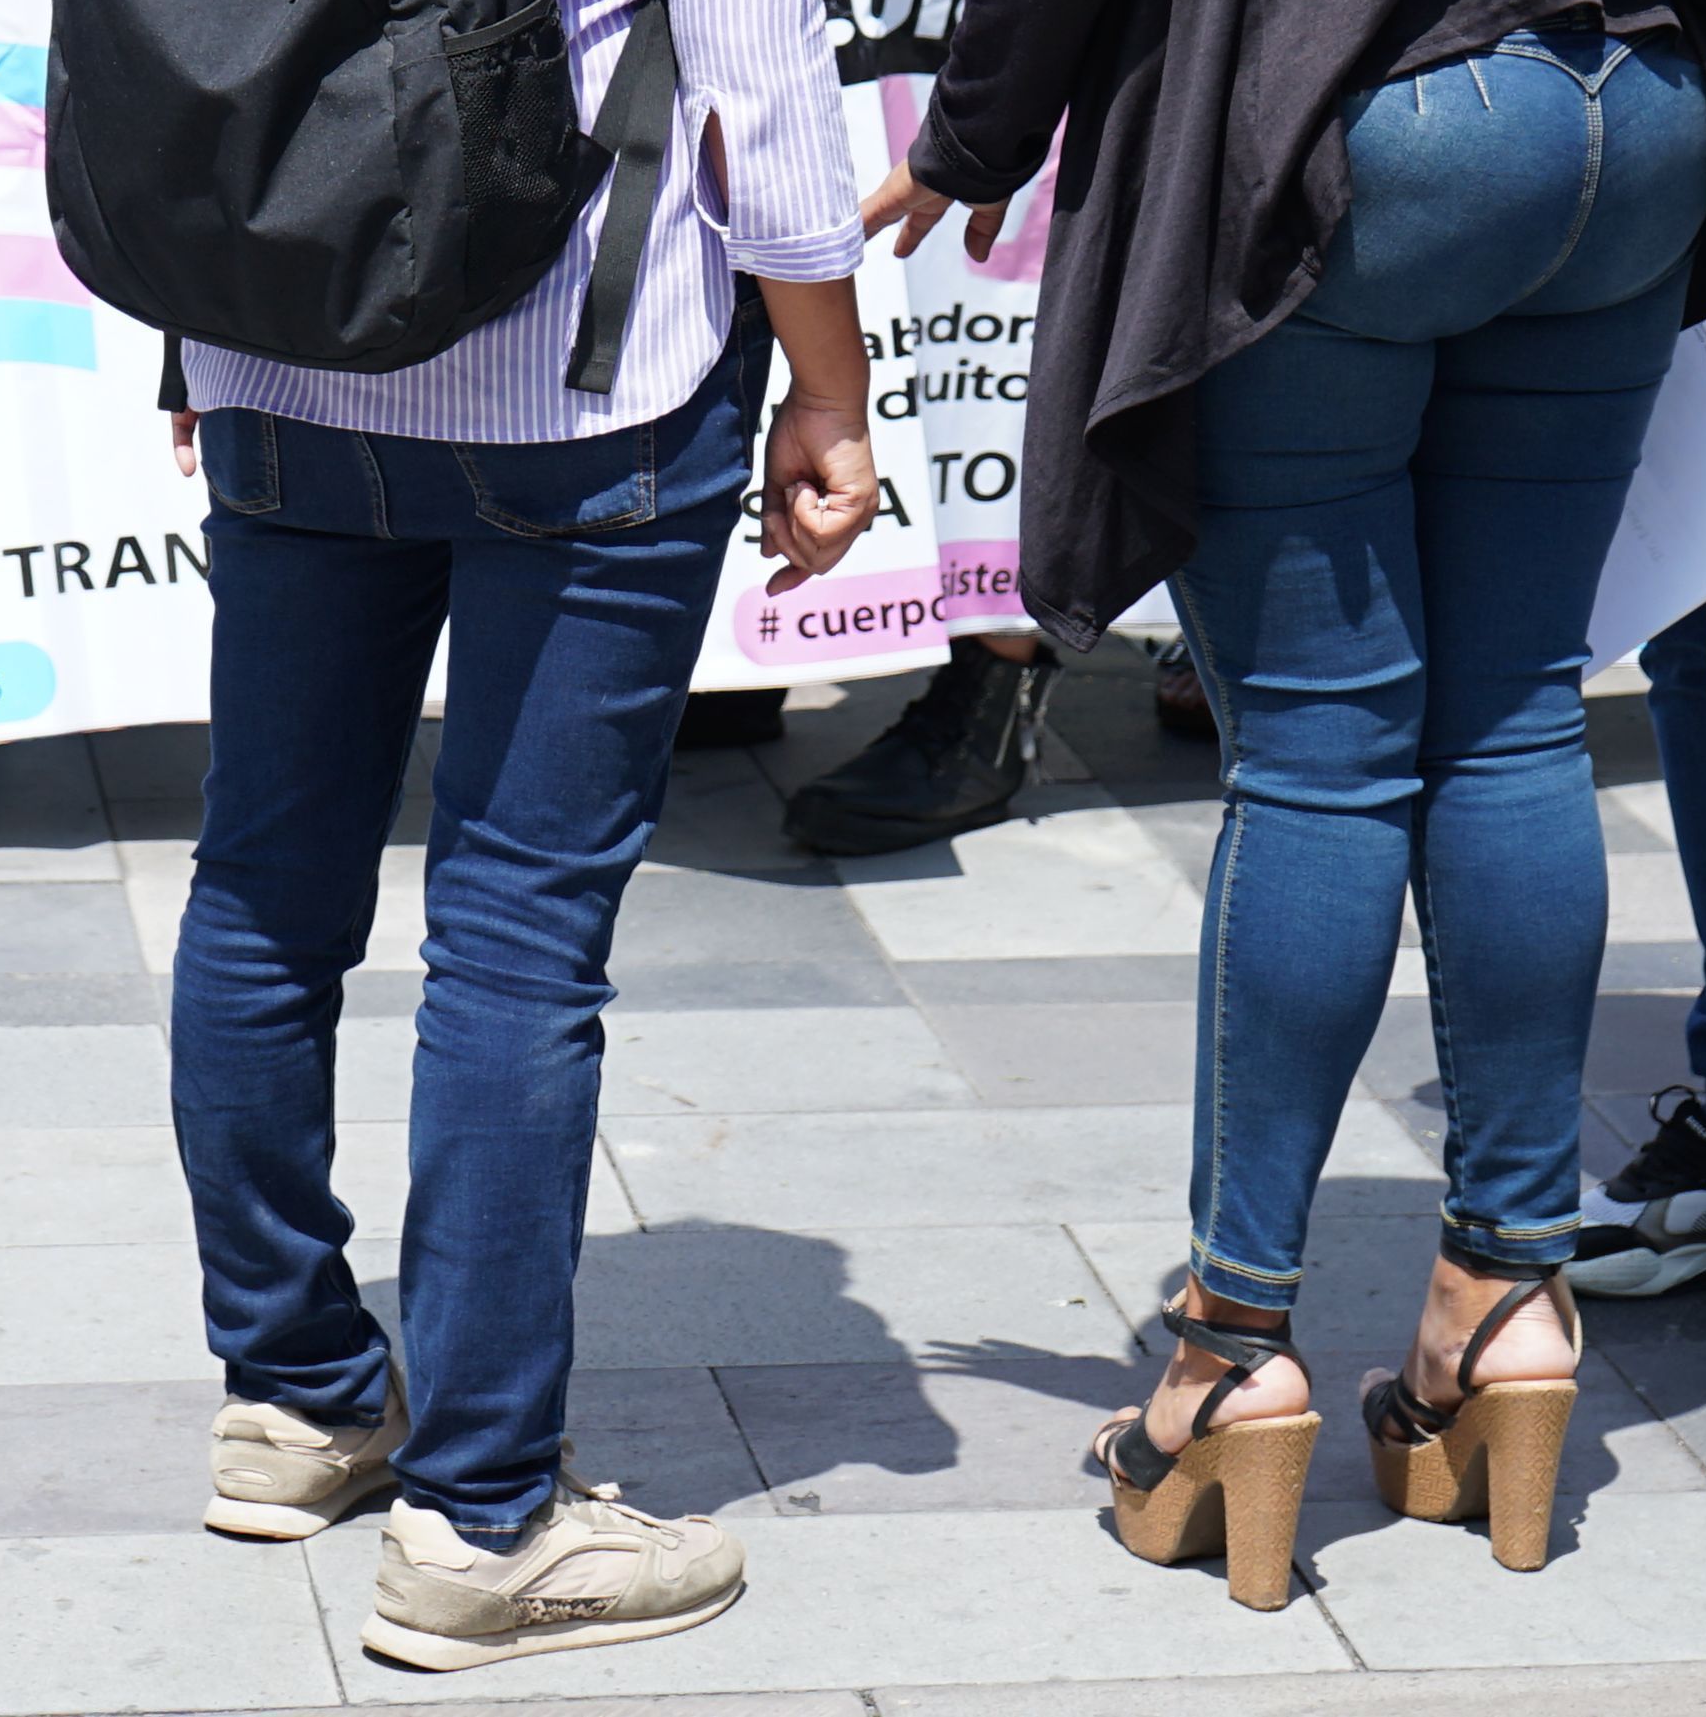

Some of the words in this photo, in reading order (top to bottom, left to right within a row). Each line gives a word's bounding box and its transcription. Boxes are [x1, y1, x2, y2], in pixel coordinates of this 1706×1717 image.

[924, 359, 1029, 403] uito
[2, 532, 212, 598] TRAN
[931, 451, 1016, 503] TO
